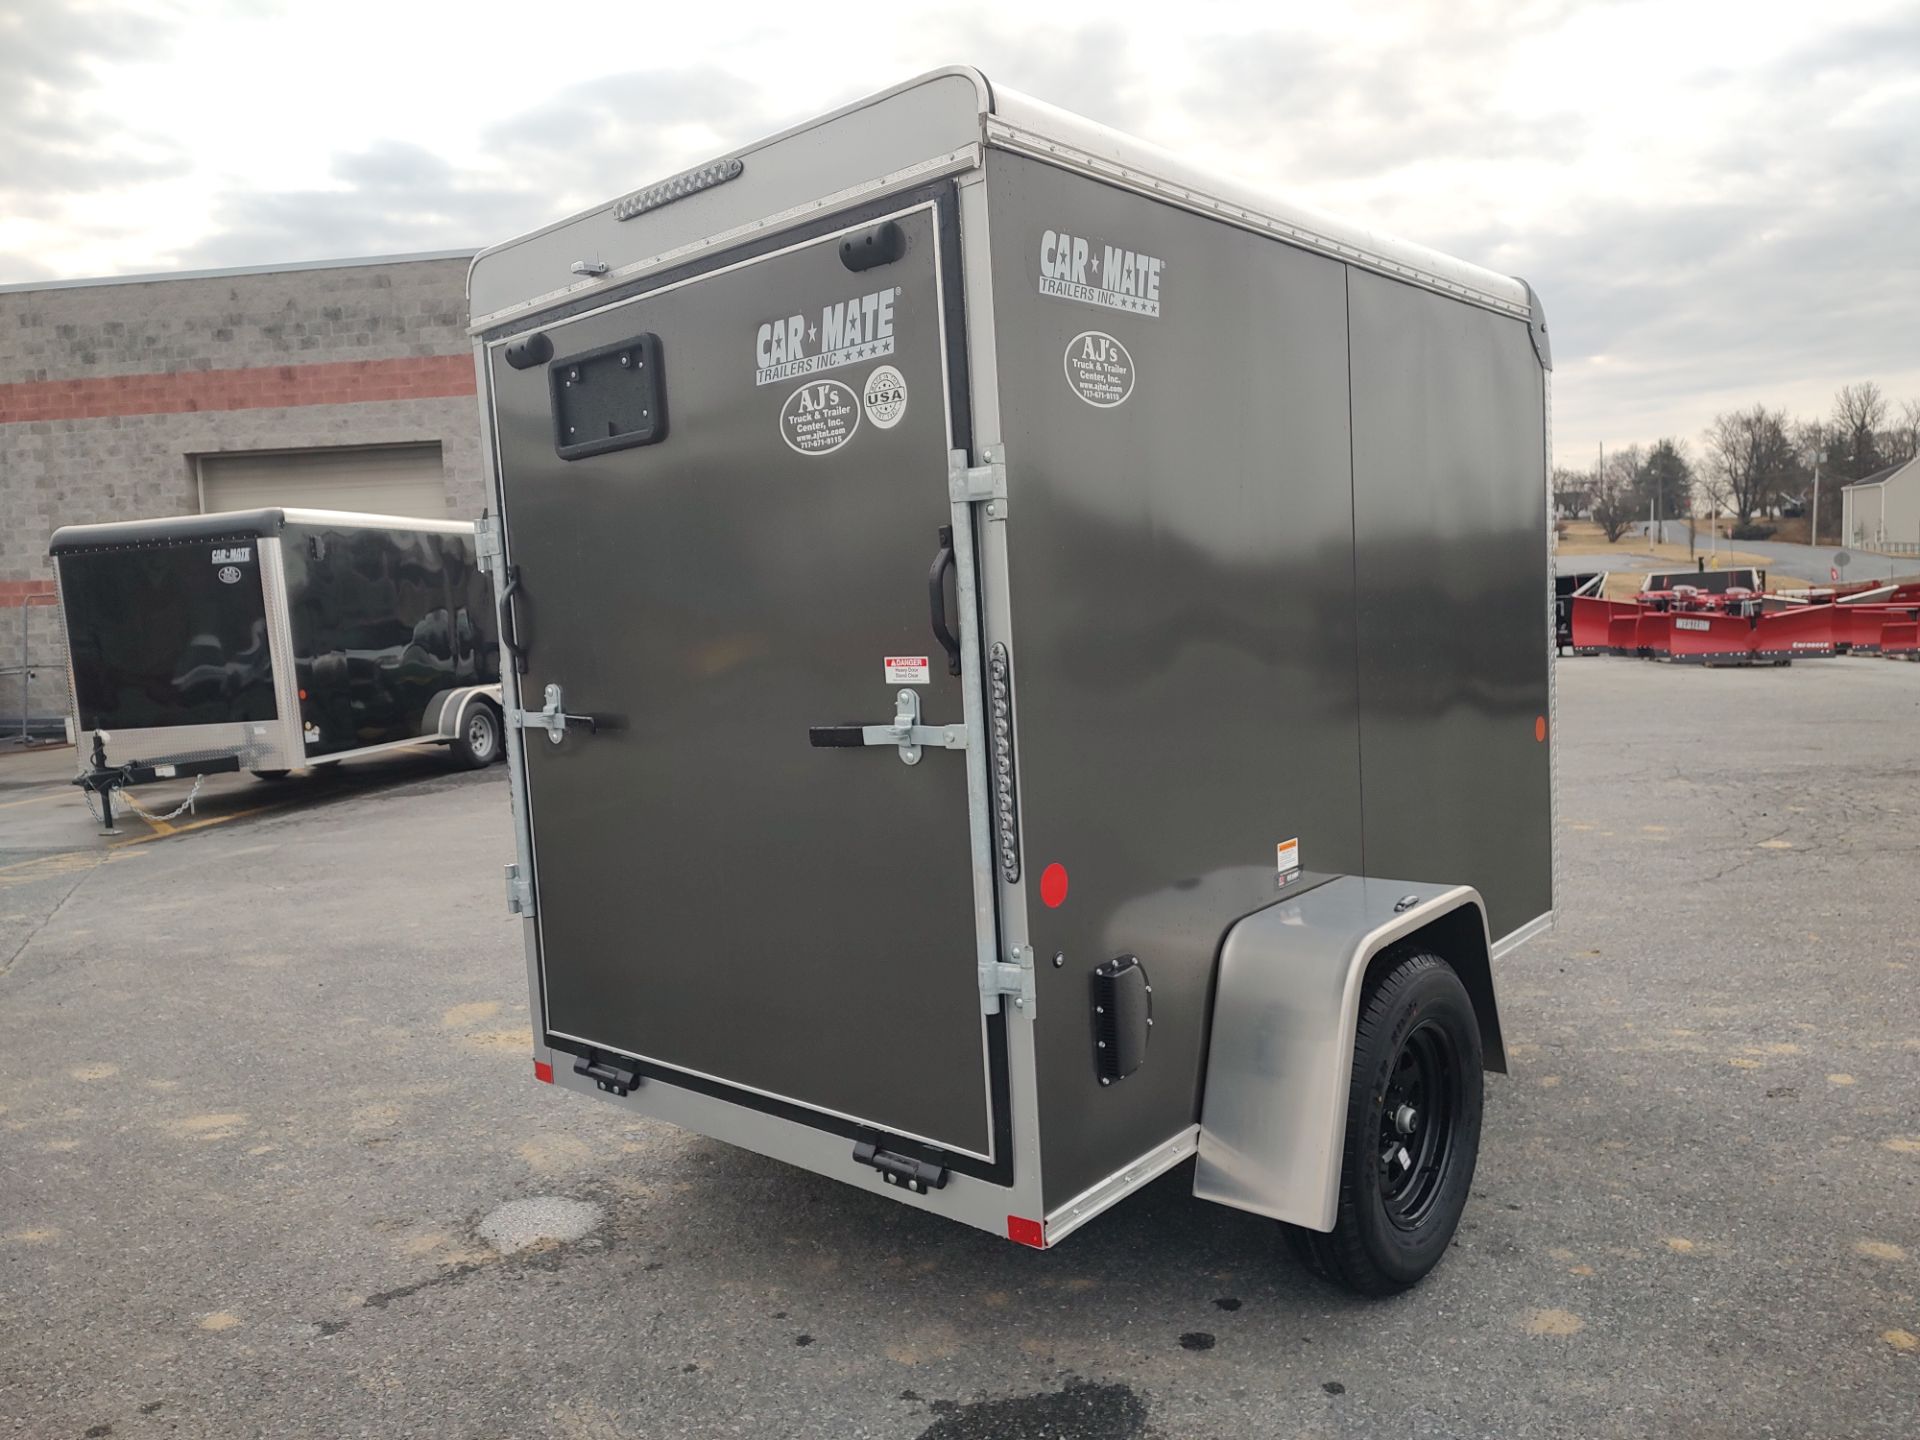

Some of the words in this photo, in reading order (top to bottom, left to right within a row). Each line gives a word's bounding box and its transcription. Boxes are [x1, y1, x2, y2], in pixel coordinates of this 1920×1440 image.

[1040, 229, 1089, 285] CAR
[1101, 244, 1161, 300] MATE
[1041, 278, 1095, 301] TRAILERS
[1097, 290, 1118, 307] INC.
[756, 314, 805, 369] CAR
[821, 287, 895, 353] MATE
[1081, 336, 1118, 362] AJ's
[758, 360, 813, 383] TRAILERS
[816, 352, 841, 370] INC.
[1072, 358, 1094, 370] Truck
[1095, 362, 1102, 371] &
[1103, 363, 1127, 374] Trailer
[1080, 370, 1106, 384] Center,
[1107, 373, 1121, 384] Inc.
[798, 384, 840, 414] AJ's
[868, 389, 902, 405] USA
[788, 412, 813, 425] Truck
[814, 410, 821, 420] &
[822, 406, 851, 418] Trailer
[796, 421, 827, 433] Center,
[827, 418, 845, 427] Inc.
[212, 550, 226, 561] CAR
